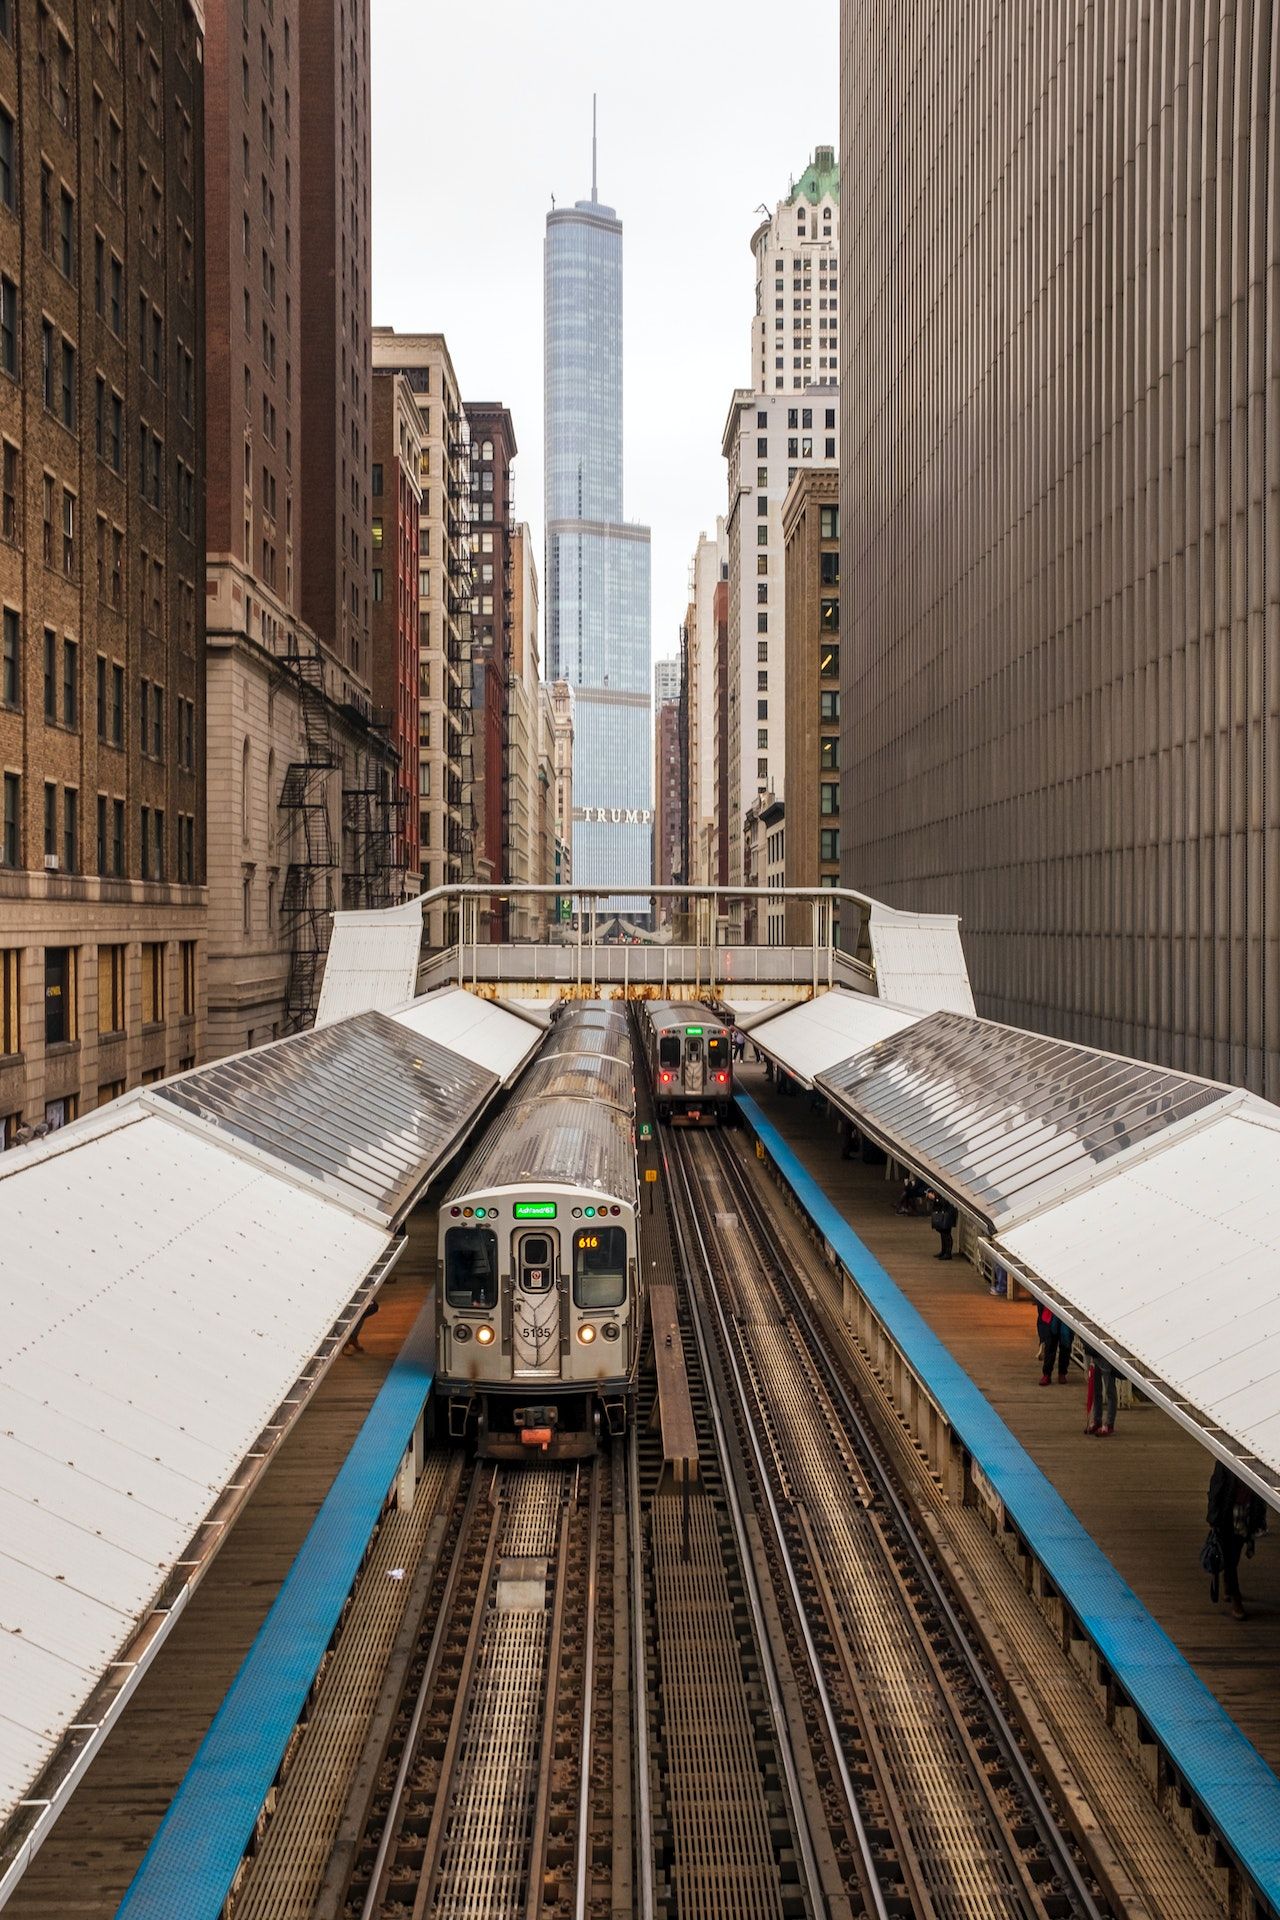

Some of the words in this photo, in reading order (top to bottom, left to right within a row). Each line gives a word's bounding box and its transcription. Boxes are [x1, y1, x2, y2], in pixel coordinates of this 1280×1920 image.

[582, 806, 650, 824] TRUMP
[642, 1125, 649, 1135] 8
[578, 1237, 598, 1248] 616
[523, 1328, 550, 1338] 5135
